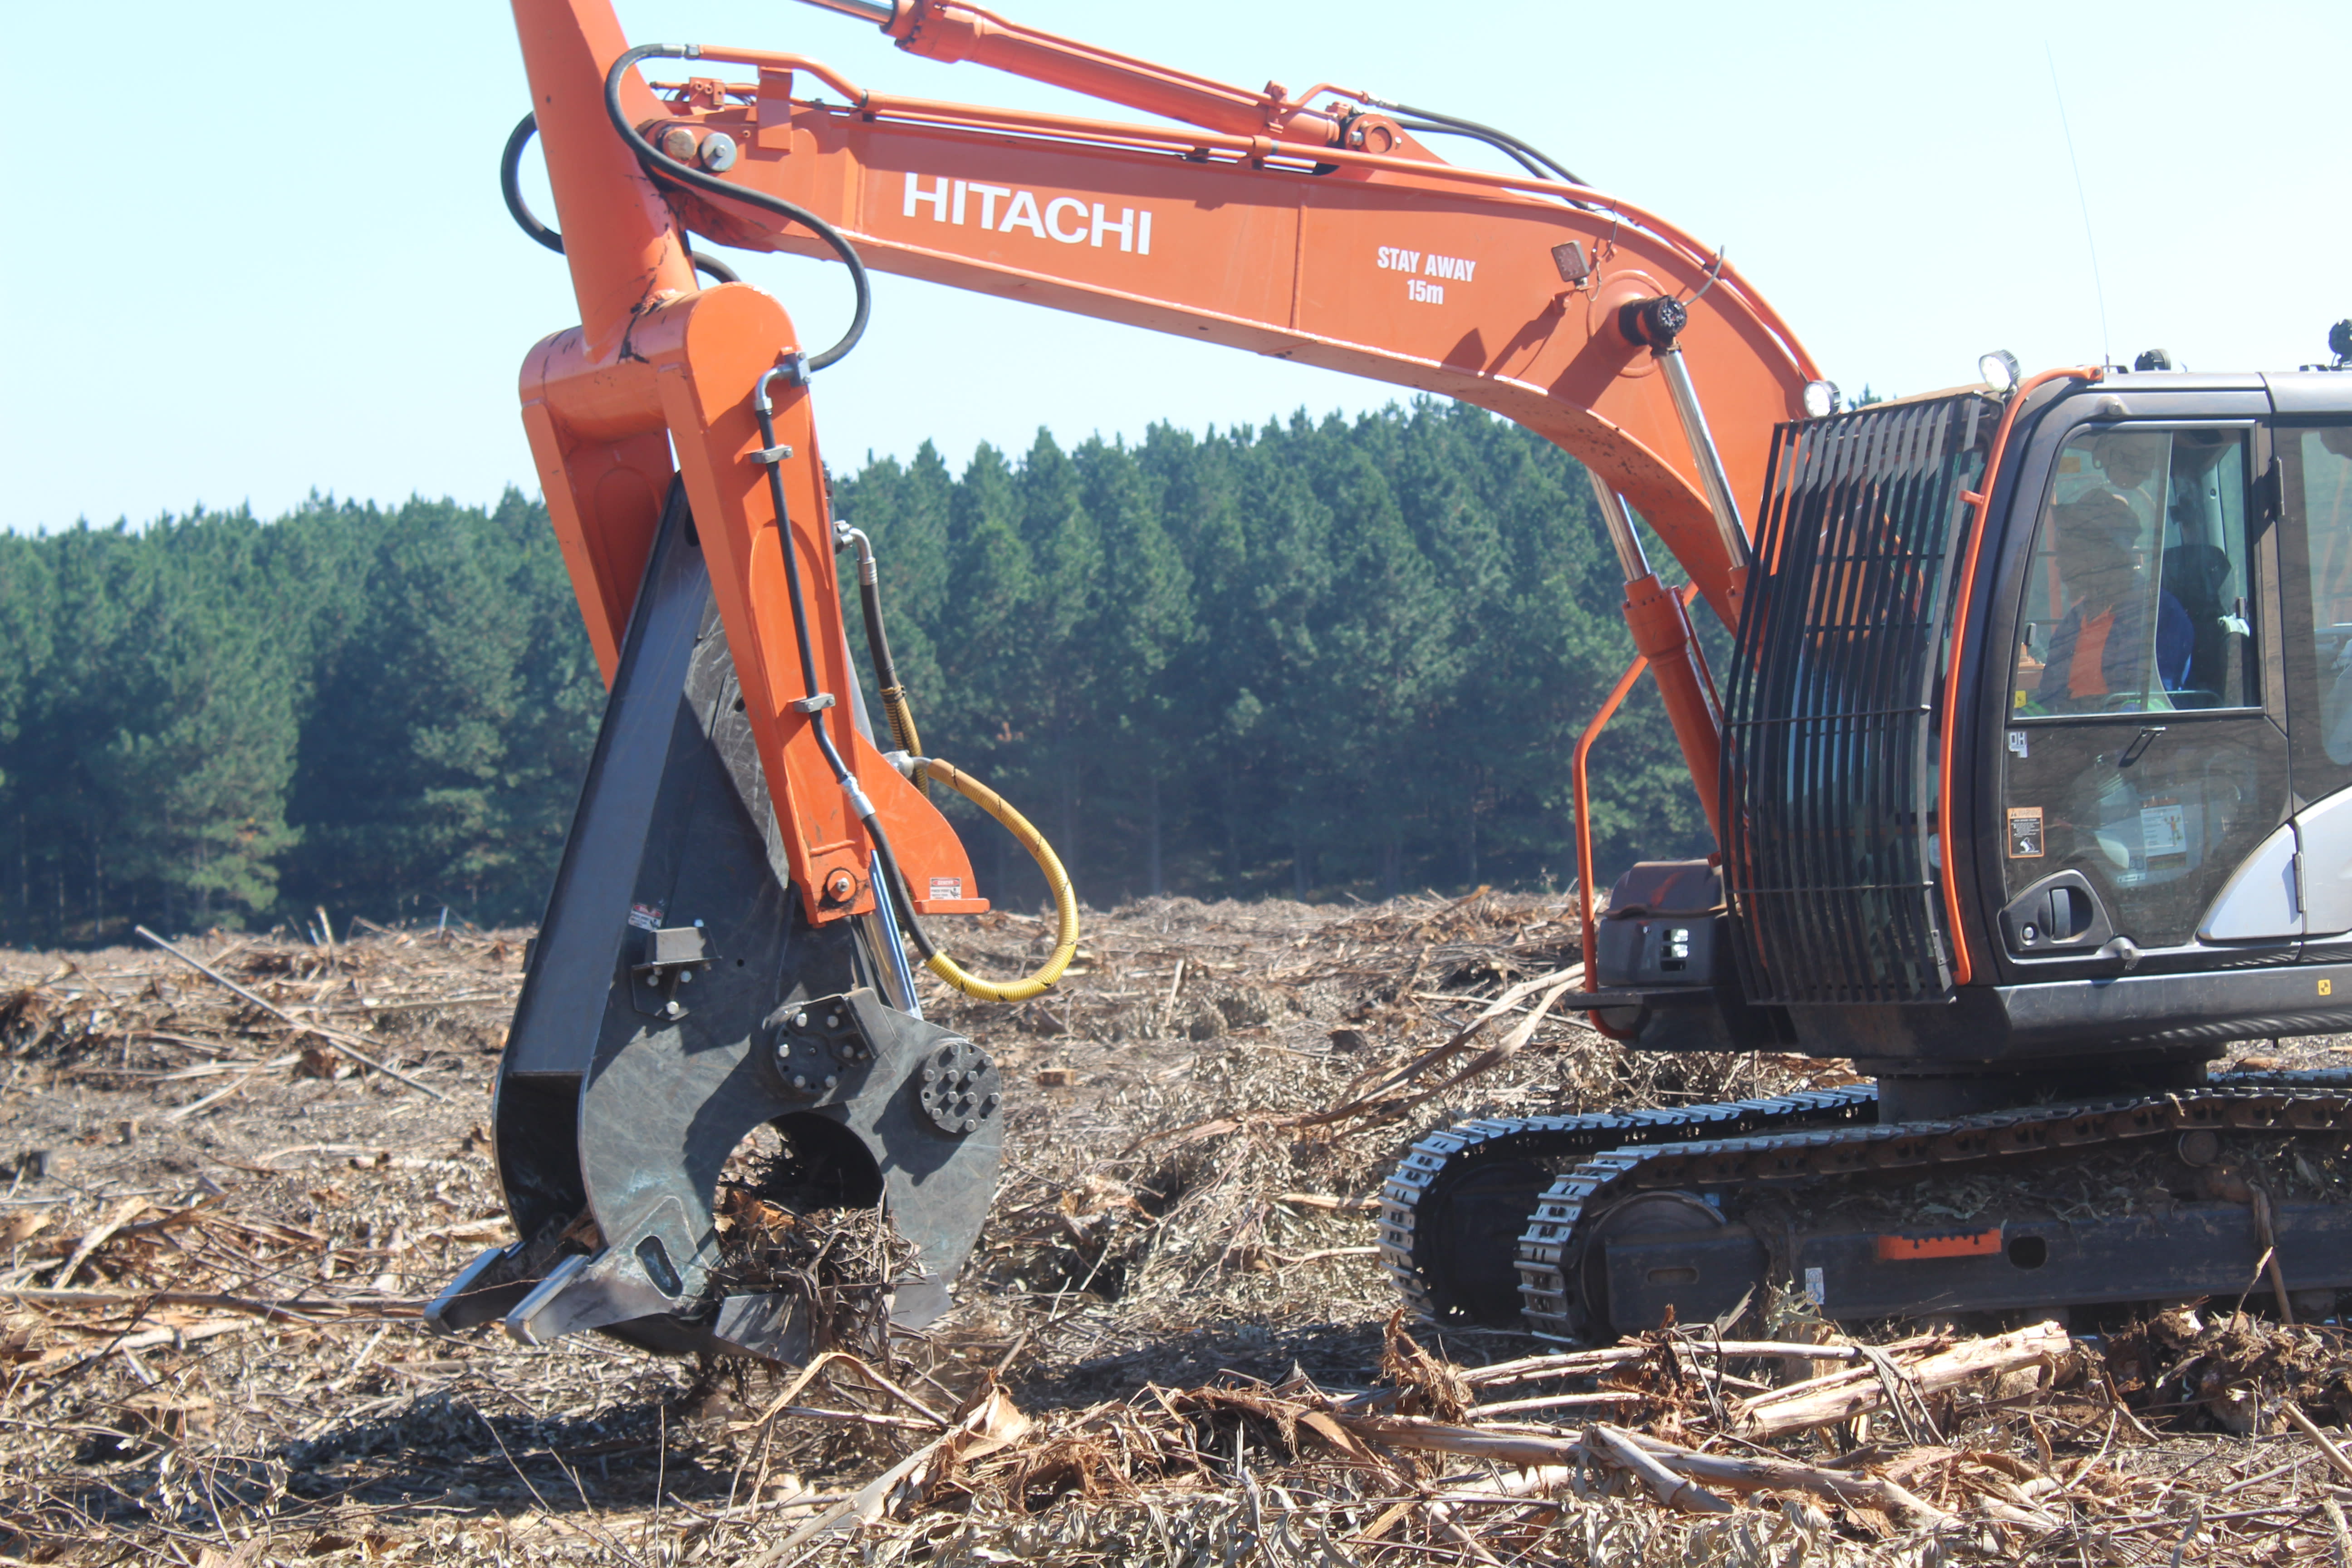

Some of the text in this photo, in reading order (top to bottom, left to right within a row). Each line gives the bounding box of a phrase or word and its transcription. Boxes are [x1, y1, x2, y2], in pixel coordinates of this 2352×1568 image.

[903, 172, 1152, 255] HITACHI
[1377, 245, 1476, 282] STAY AWAY
[1407, 279, 1444, 305] 15m
